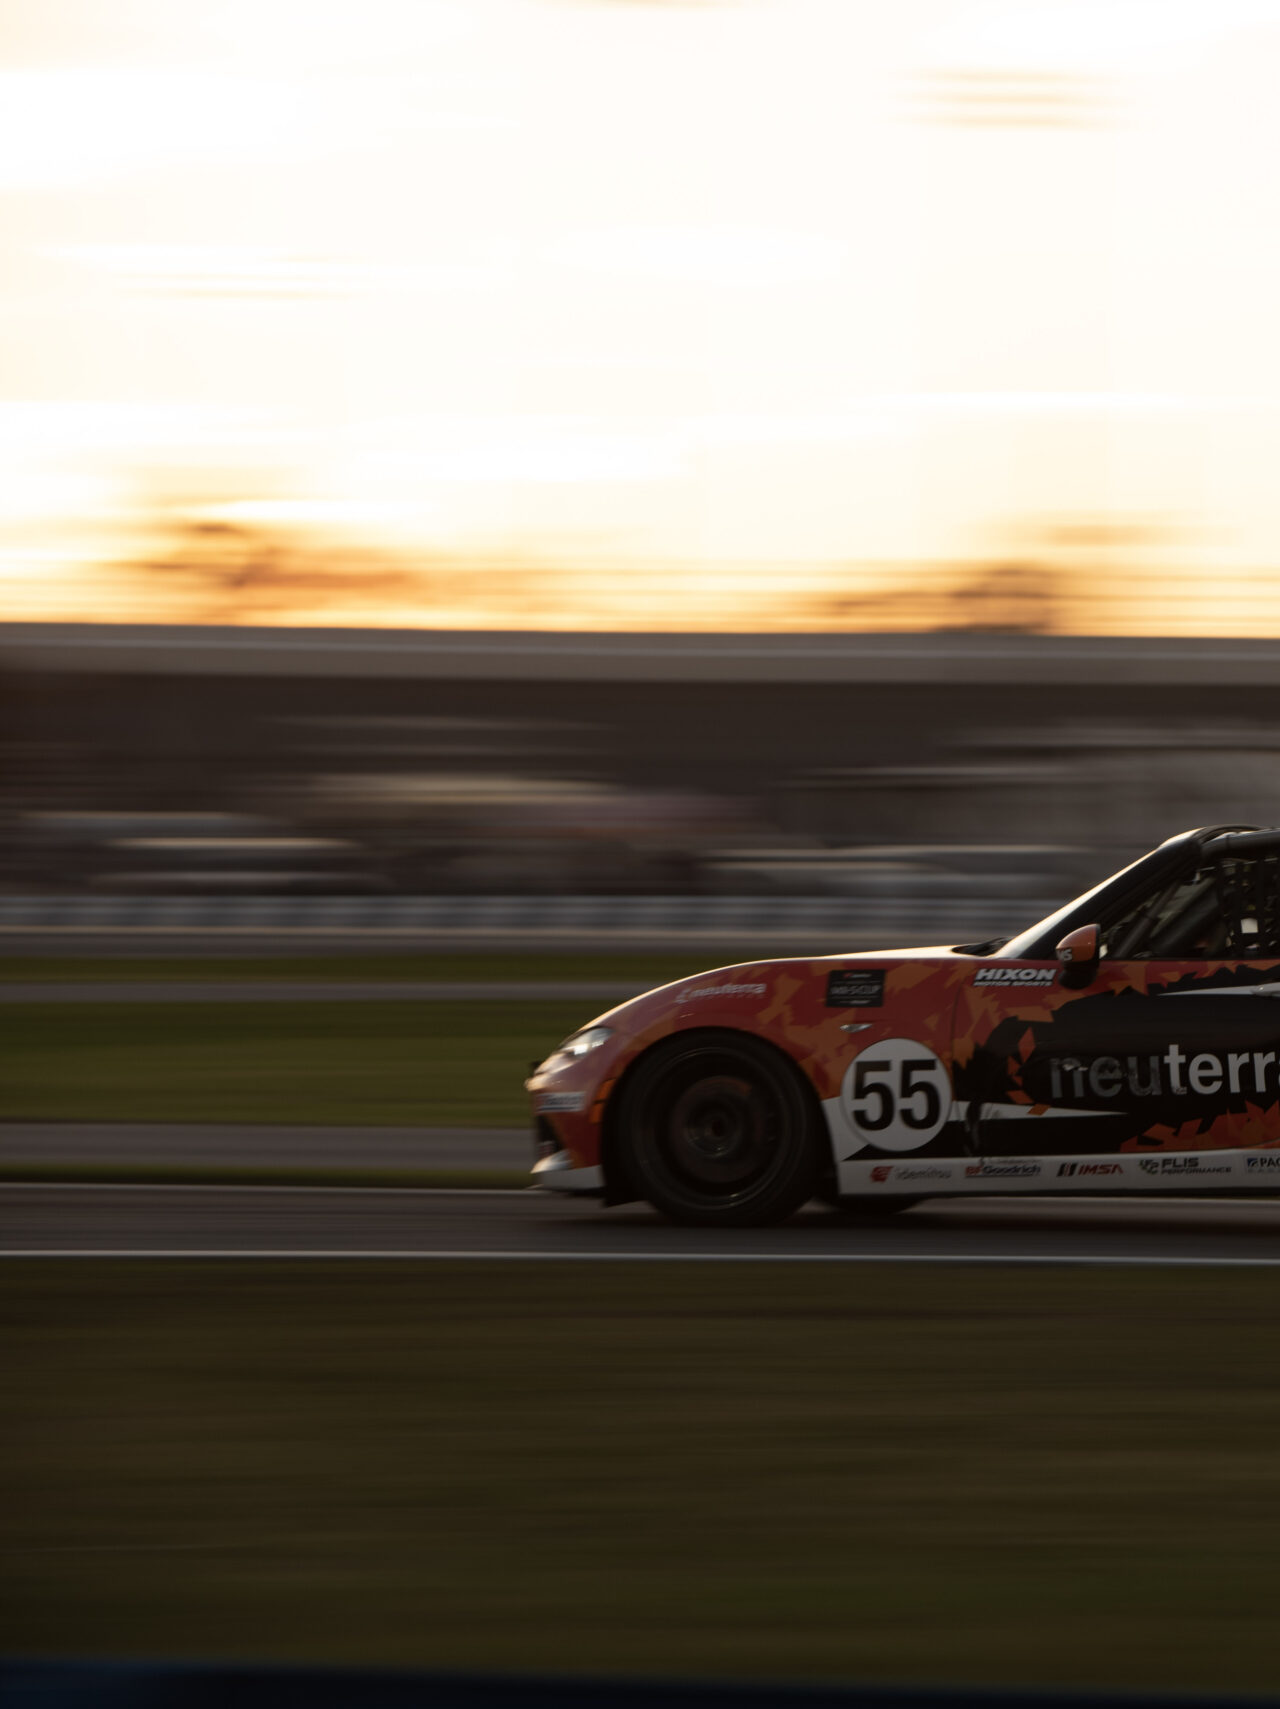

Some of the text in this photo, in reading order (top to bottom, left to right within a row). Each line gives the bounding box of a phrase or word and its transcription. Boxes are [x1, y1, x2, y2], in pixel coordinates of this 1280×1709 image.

[975, 968, 1057, 980] HIXON
[852, 1060, 940, 1132] 55
[1162, 1158, 1199, 1168] FLIS
[1078, 1164, 1124, 1175] IMSA
